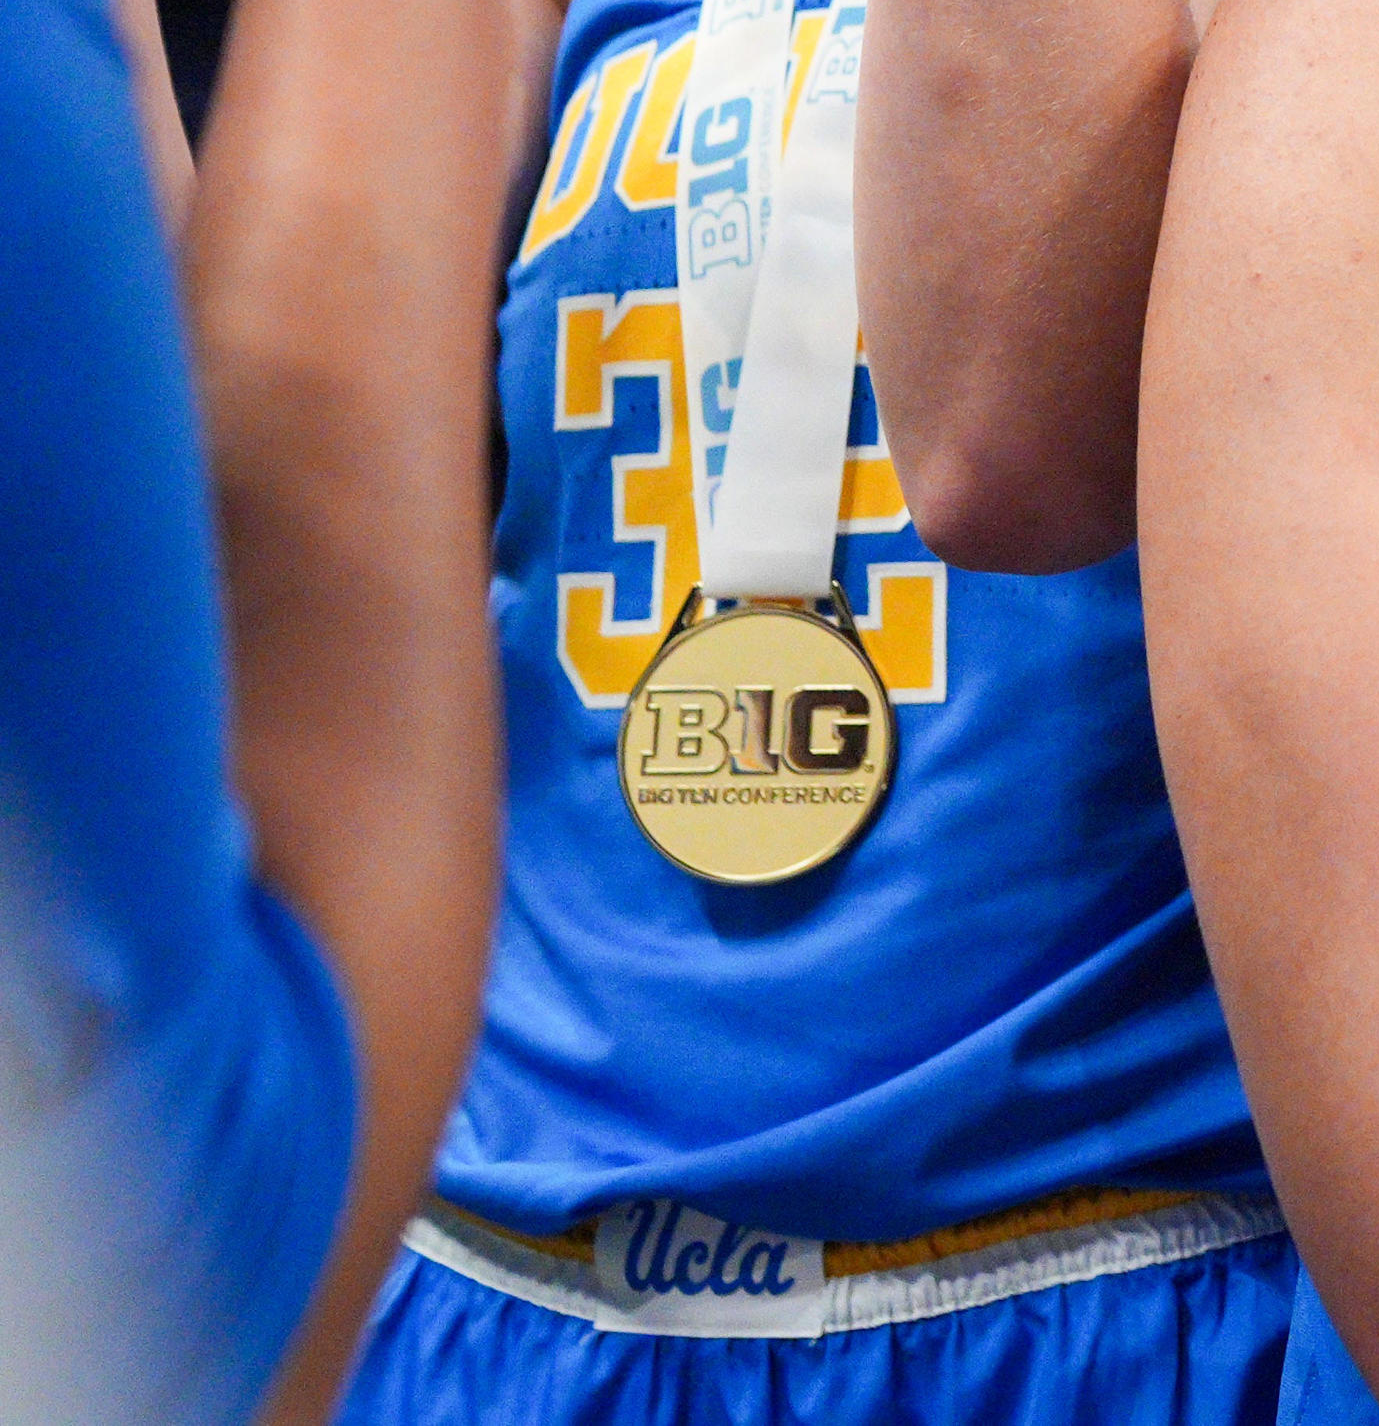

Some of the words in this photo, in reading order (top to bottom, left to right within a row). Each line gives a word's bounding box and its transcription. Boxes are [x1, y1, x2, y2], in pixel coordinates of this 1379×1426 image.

[676, 786, 717, 805] TEN
[721, 784, 866, 805] CONFERENCE
[624, 1200, 795, 1296] Ucla
